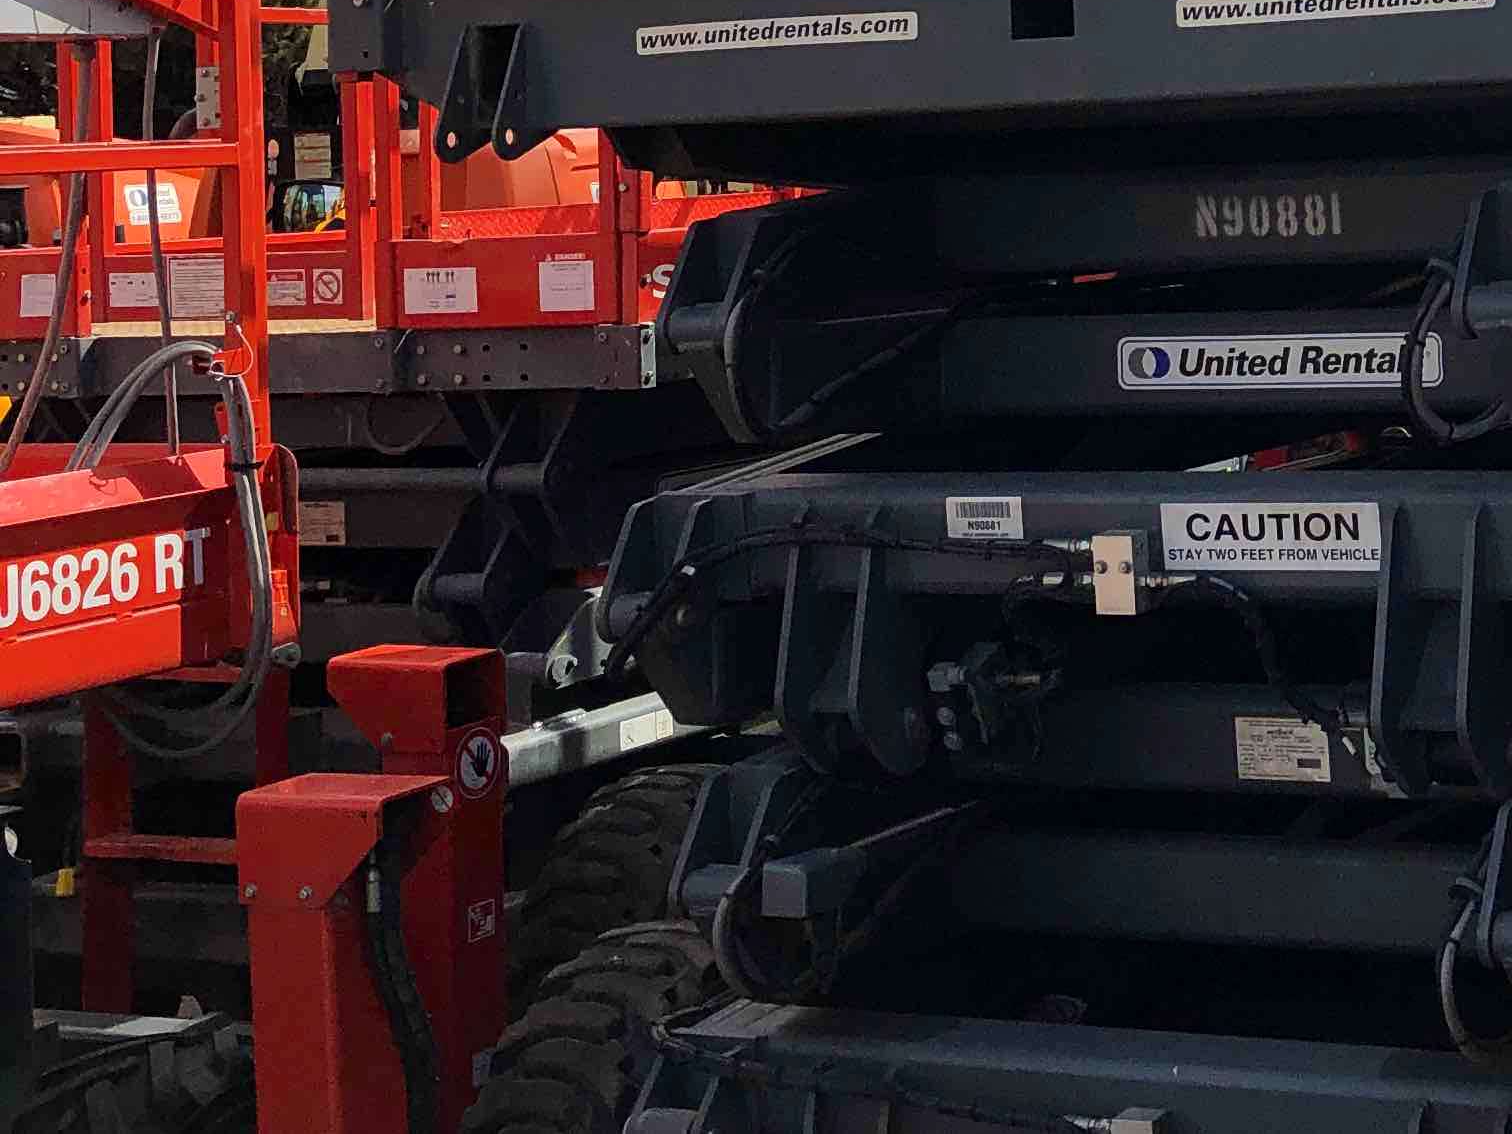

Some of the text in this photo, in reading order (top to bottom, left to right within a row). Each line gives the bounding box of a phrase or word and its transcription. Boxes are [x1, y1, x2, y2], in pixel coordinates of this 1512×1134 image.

[639, 16, 910, 49] www.unitedrentals.com
[1195, 192, 1342, 237] N90881
[1179, 345, 1405, 378] United Rental
[1185, 513, 1361, 542] CAUTION
[154, 526, 211, 594] RT
[1168, 548, 1380, 561] STAY TWO FEET FROM VEHICLE
